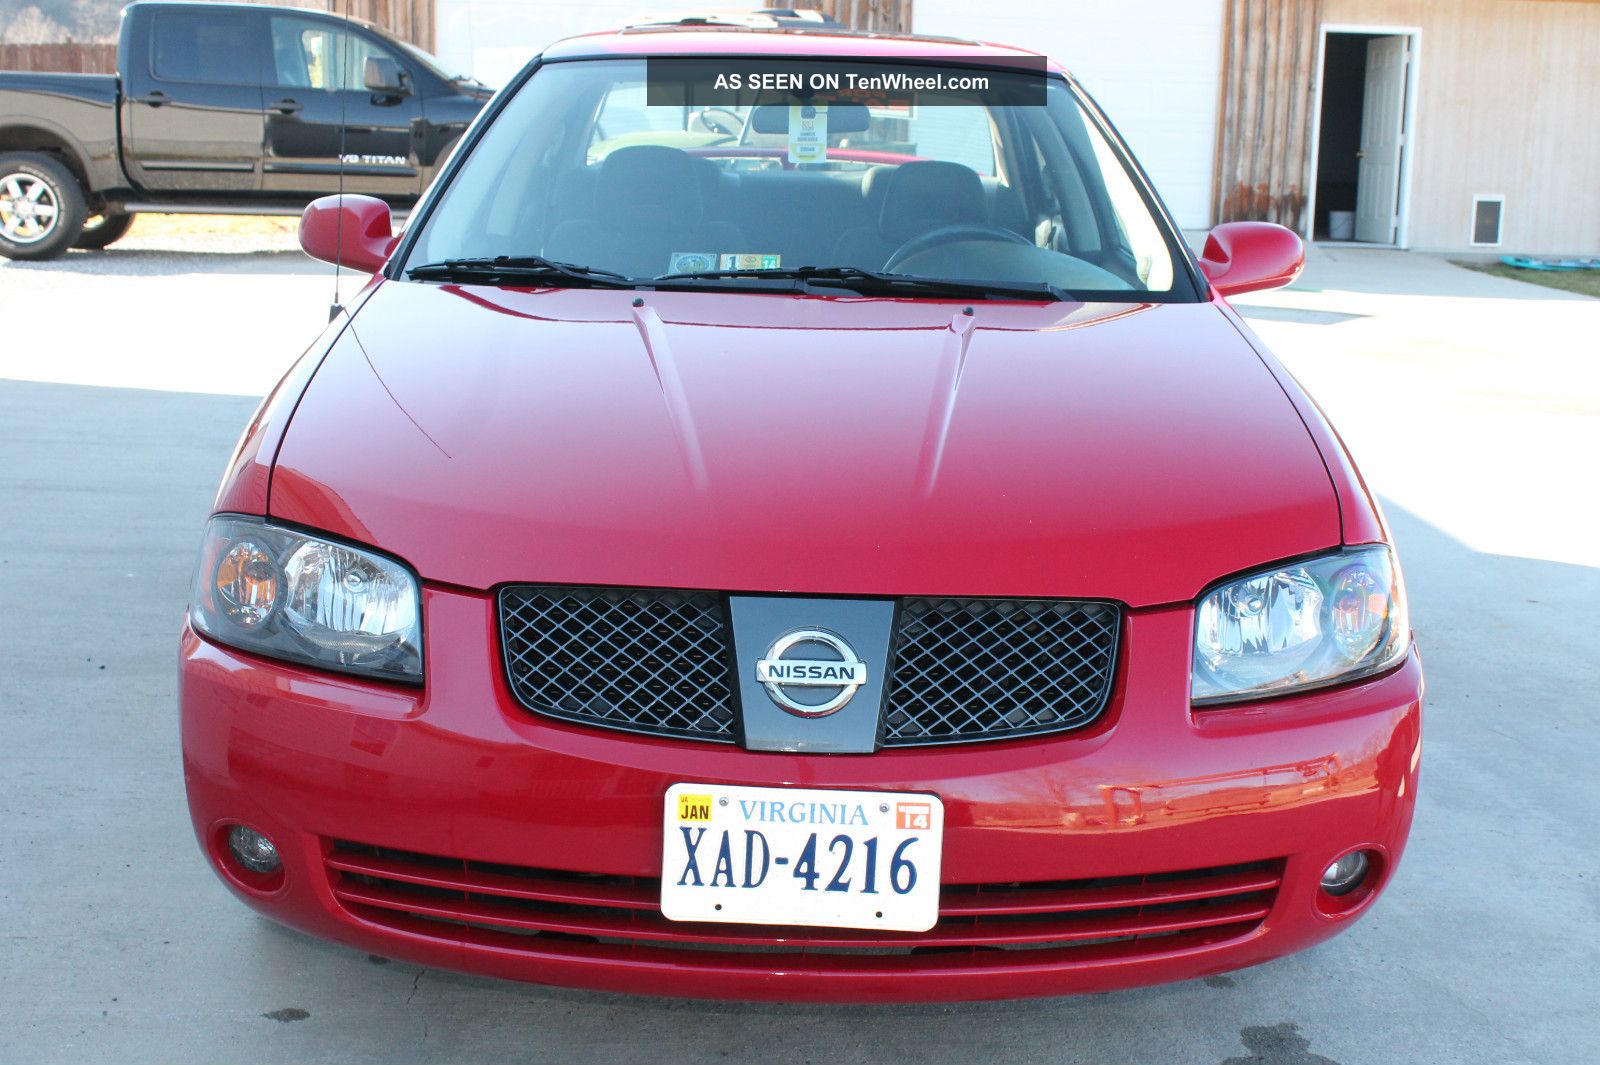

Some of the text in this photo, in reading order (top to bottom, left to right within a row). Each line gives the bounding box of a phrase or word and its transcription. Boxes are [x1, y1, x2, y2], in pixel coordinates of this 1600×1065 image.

[361, 154, 406, 165] TITAN
[768, 665, 855, 680] NISSAN
[681, 805, 709, 820] JAN
[738, 800, 869, 826] VIRGINIA
[904, 812, 928, 830] 14
[676, 826, 919, 895] XAD-4216
